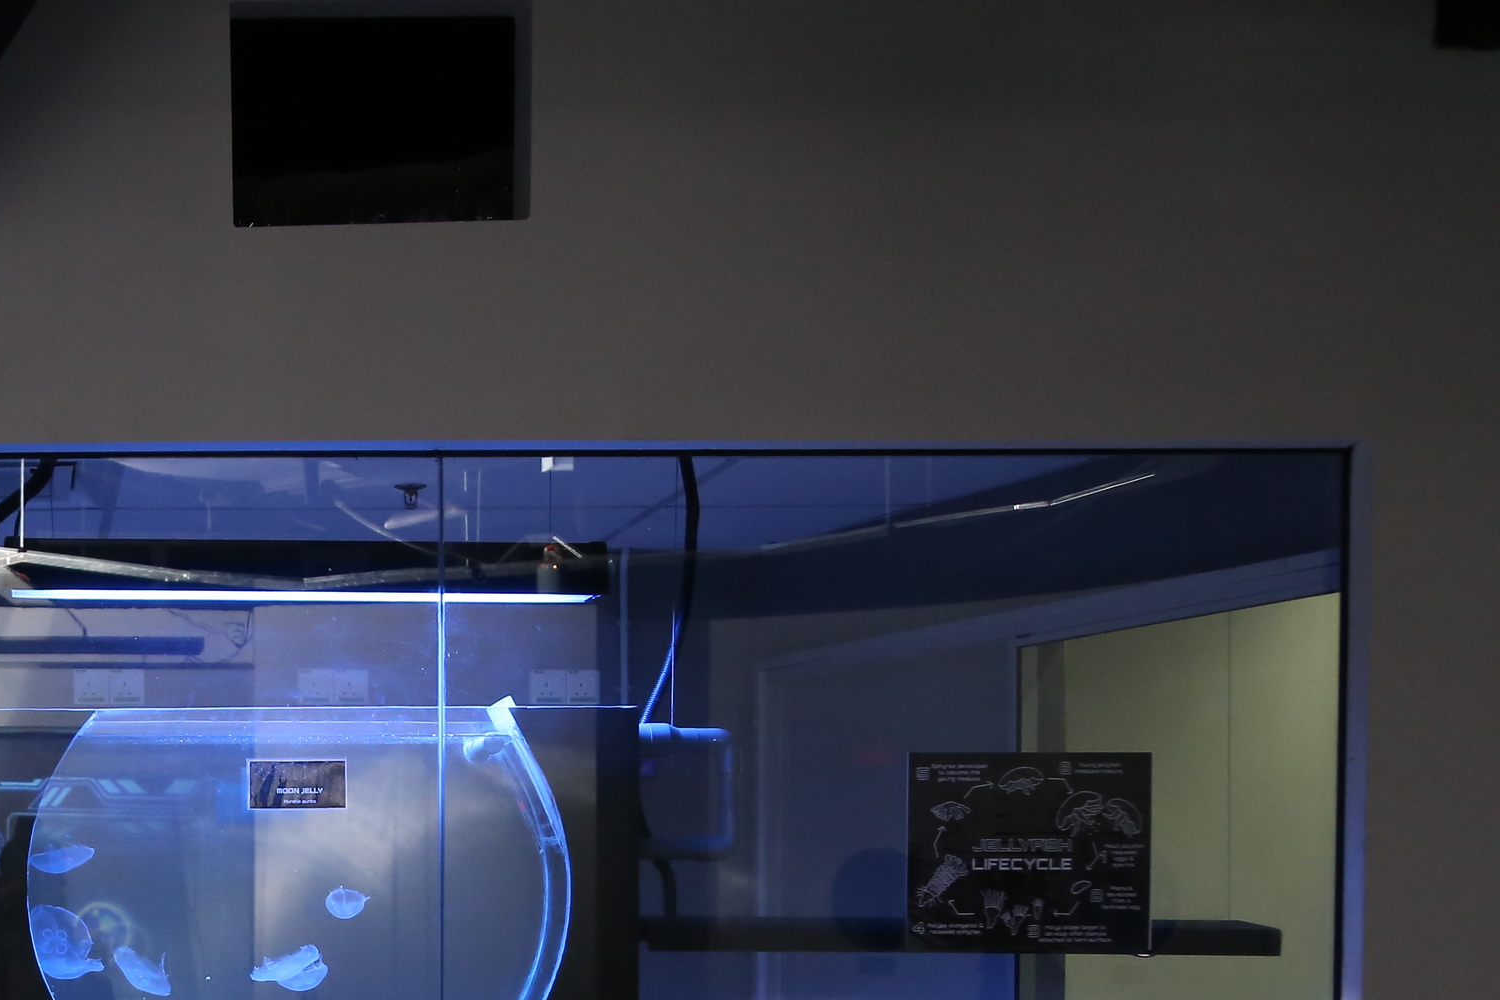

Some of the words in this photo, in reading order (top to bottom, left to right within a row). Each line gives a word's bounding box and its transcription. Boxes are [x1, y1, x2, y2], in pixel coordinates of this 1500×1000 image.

[916, 767, 930, 781] 5
[1059, 761, 1071, 775] 6
[972, 838, 1072, 852] JELLYFISH
[972, 858, 1072, 870] LIFECYCLE
[1090, 888, 1103, 903] 2
[912, 921, 925, 935] 4
